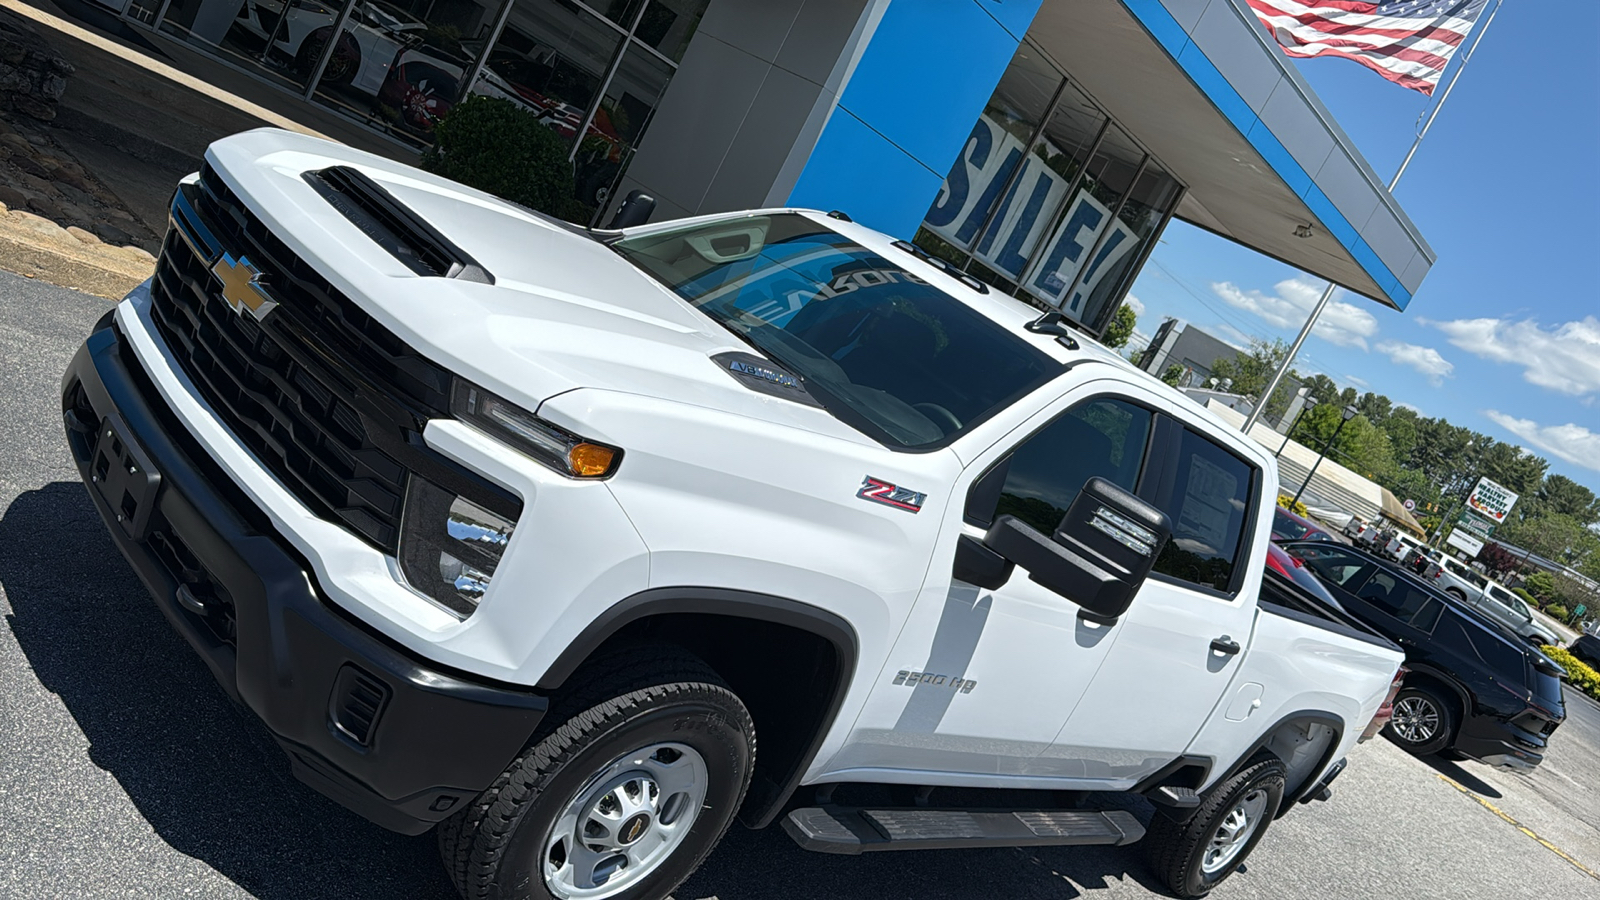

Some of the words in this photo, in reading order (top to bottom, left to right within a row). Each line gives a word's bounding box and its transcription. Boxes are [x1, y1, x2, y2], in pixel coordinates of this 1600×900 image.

[922, 117, 1127, 313] SALE!
[856, 474, 928, 514] Z71
[1477, 490, 1508, 509] HARVEST
[1478, 483, 1507, 501] HEALTHY
[1477, 496, 1507, 515] PRODUCE
[892, 670, 948, 686] 2500
[949, 677, 977, 693] HD
